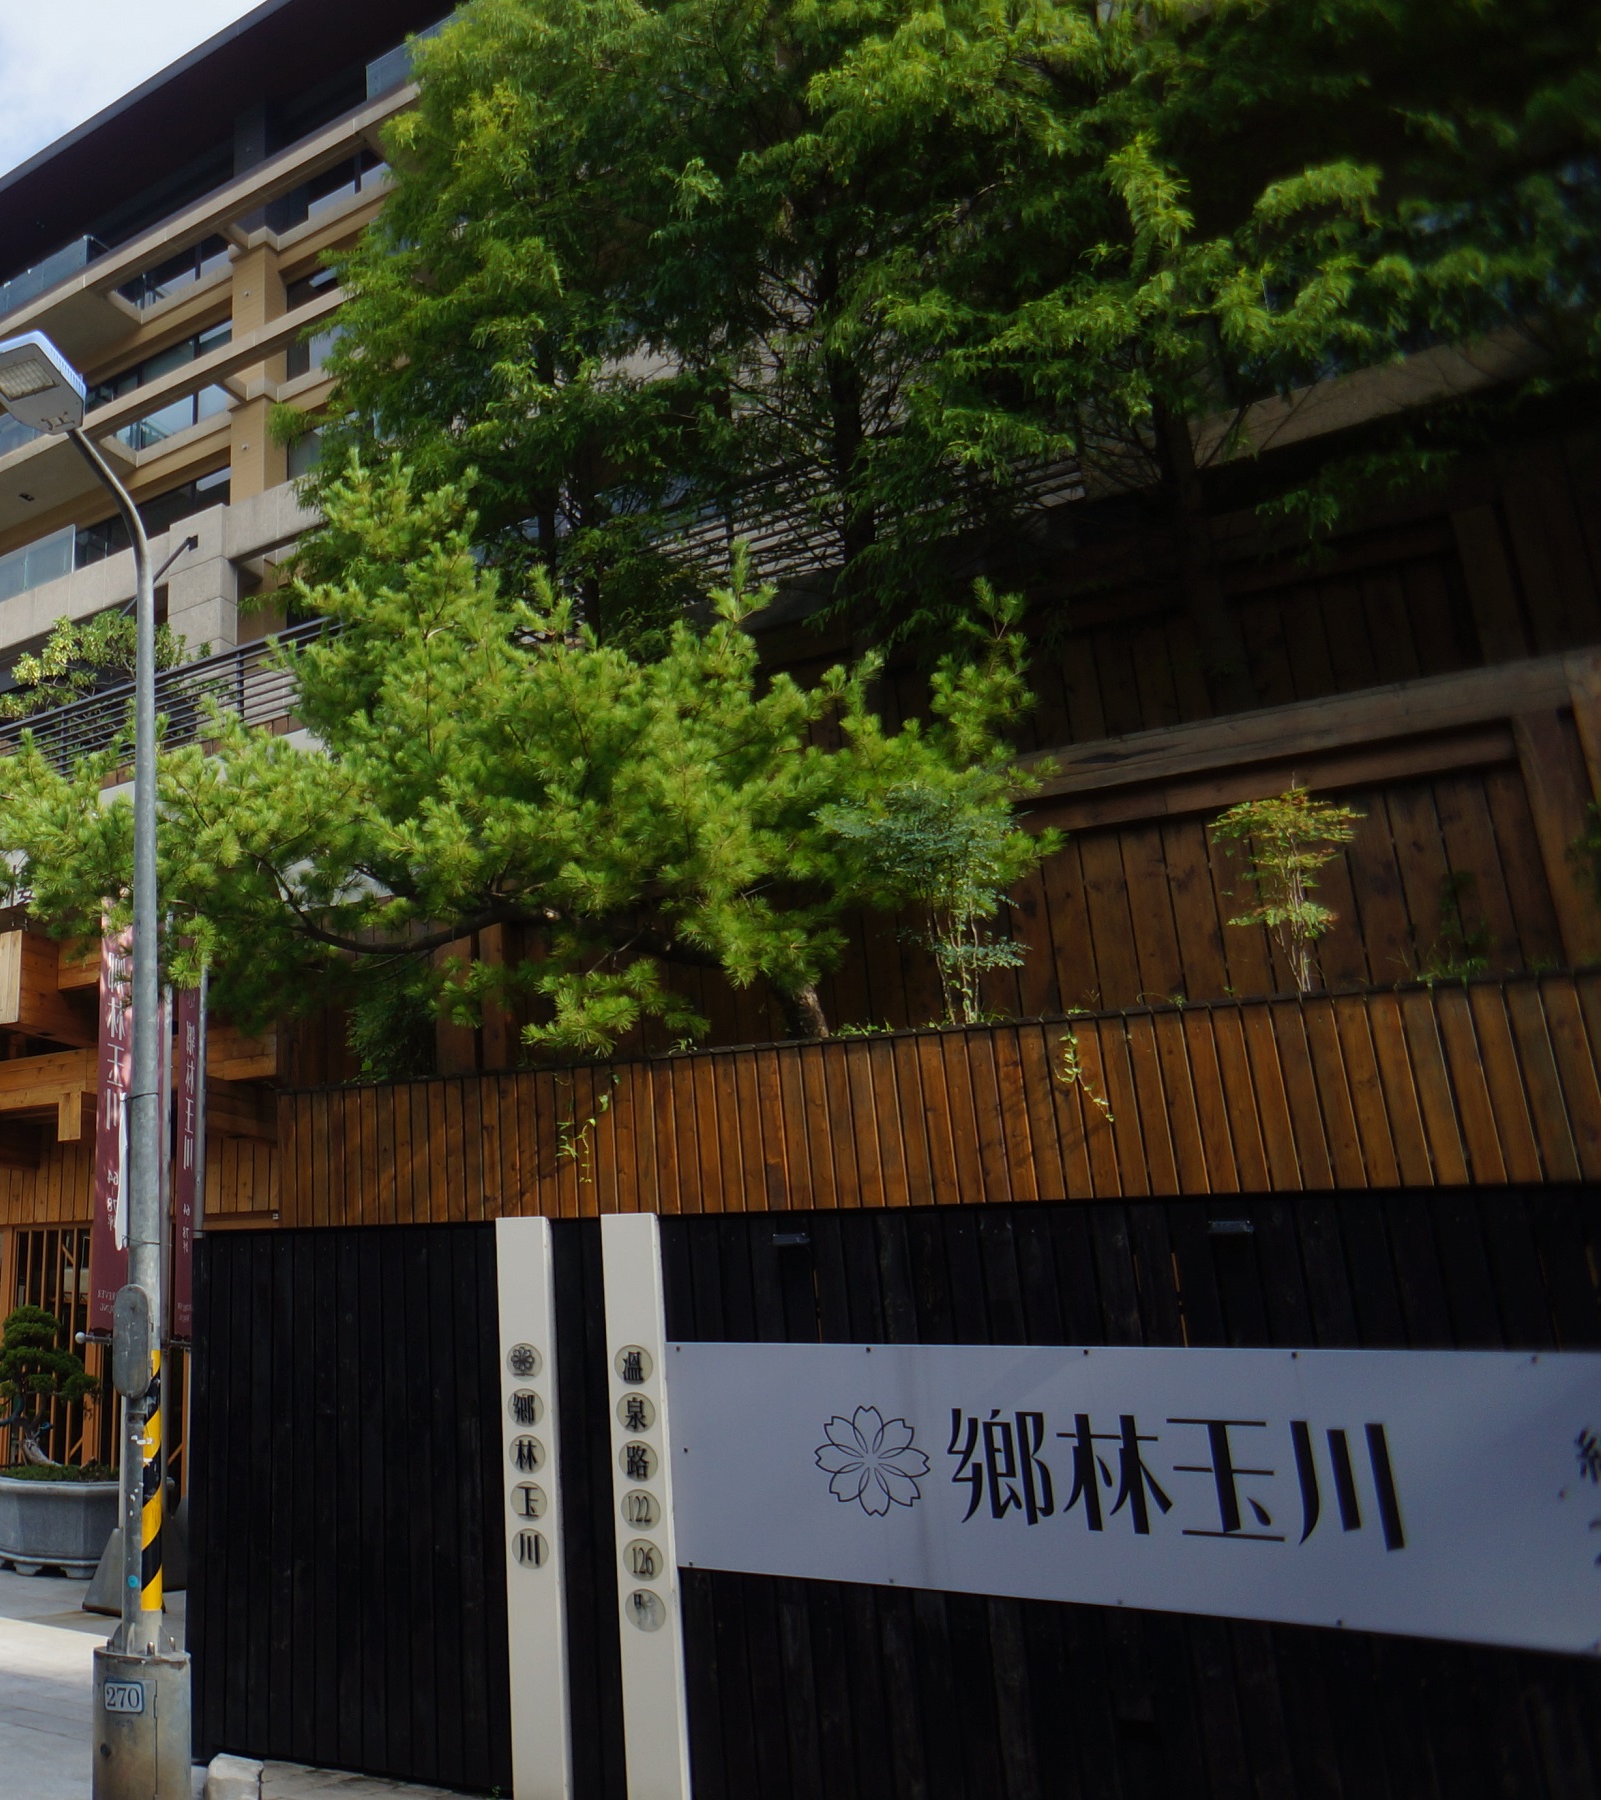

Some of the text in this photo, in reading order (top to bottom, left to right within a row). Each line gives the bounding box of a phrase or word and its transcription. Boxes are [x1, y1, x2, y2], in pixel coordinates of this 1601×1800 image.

[512, 1393, 541, 1567] 鄉林玉川
[946, 1407, 1406, 1552] 鄉林玉川
[106, 1687, 140, 1709] 270
